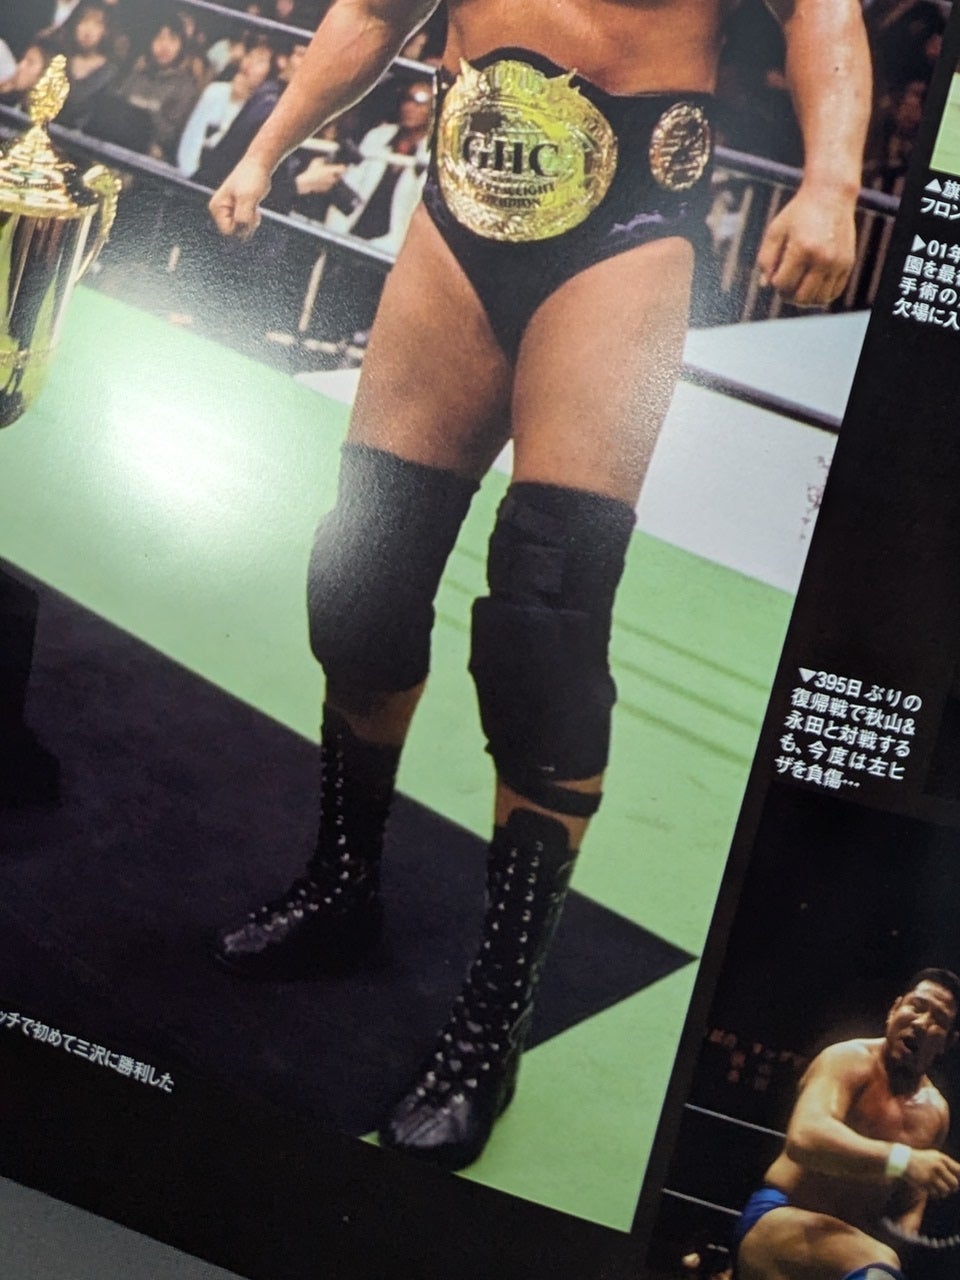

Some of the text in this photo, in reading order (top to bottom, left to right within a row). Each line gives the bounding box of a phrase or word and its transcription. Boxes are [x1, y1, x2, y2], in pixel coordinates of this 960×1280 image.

[813, 671, 923, 712] 395日ぶりの
[779, 732, 906, 780] も、今度は左ヒ
[783, 709, 911, 758] 永田と対戦する
